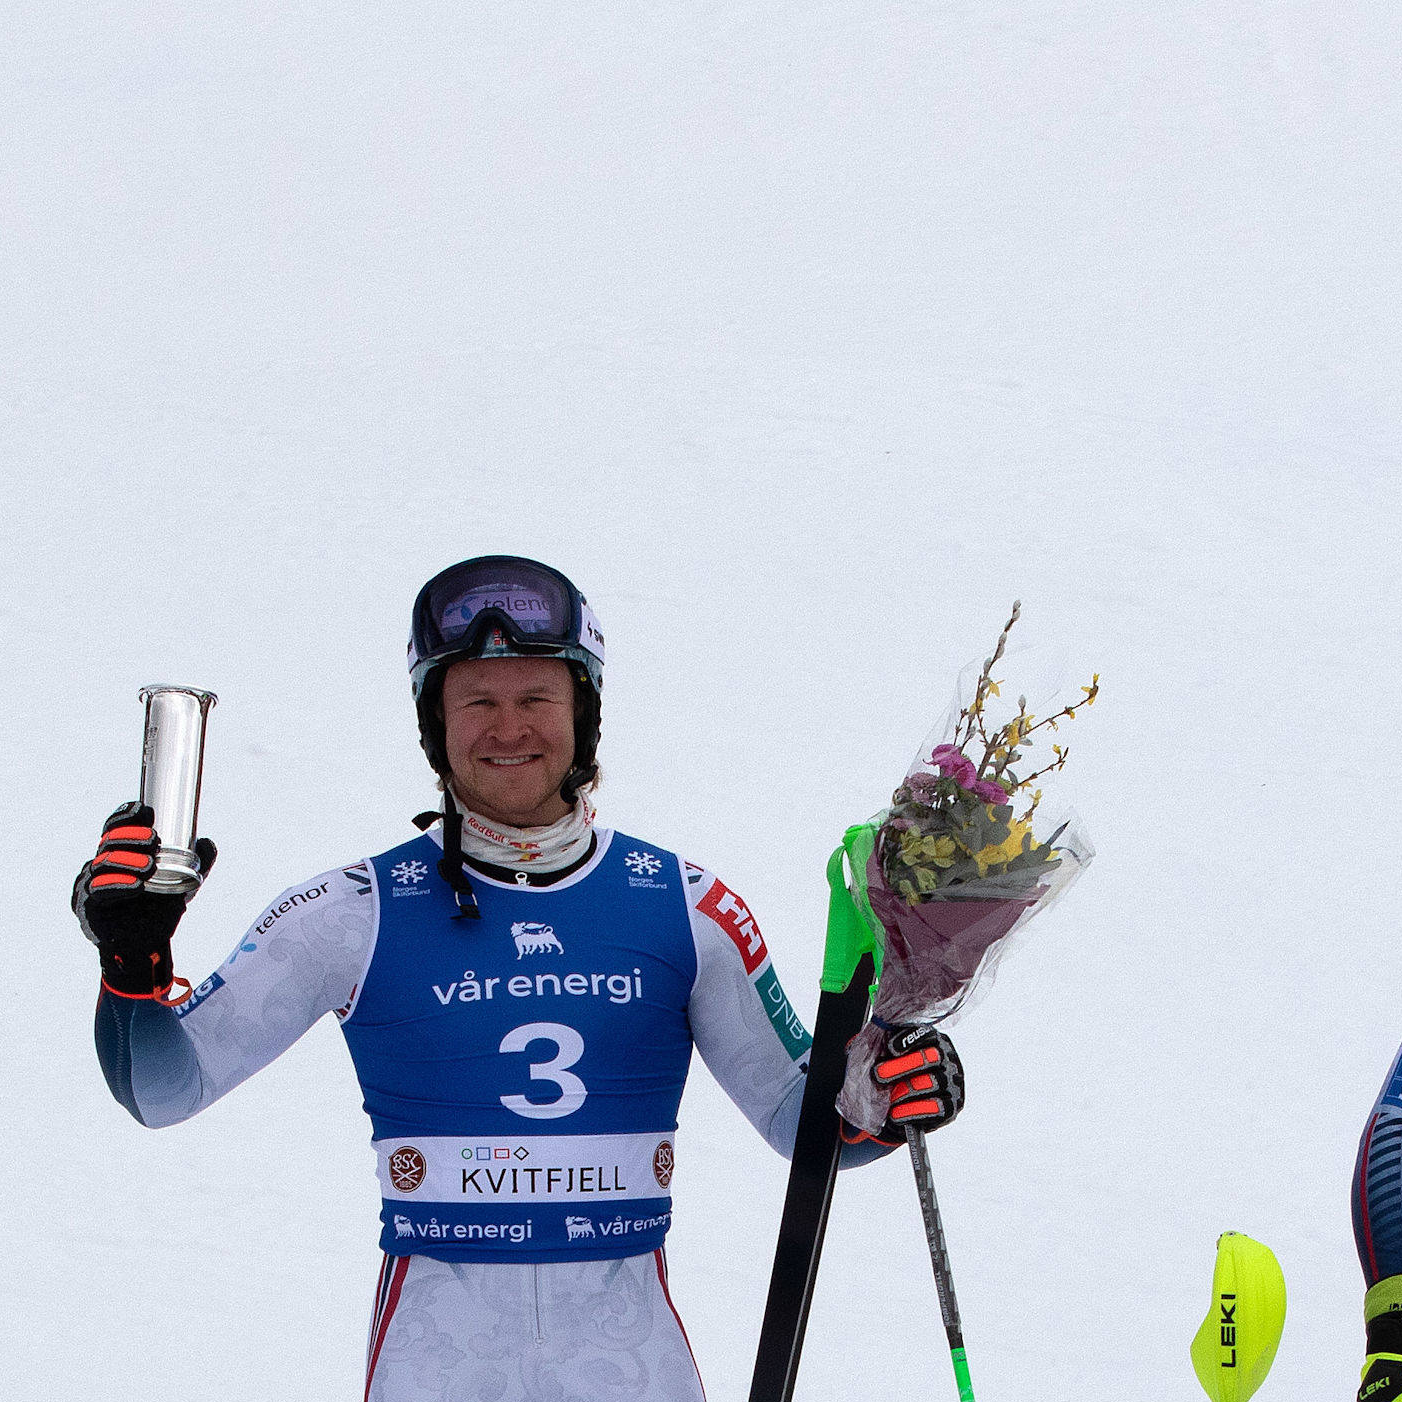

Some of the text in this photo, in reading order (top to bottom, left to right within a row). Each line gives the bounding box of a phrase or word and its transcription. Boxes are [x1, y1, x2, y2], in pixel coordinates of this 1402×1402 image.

[255, 880, 329, 935] telenor
[716, 890, 763, 957] HH
[432, 968, 642, 1005] vår energi
[767, 980, 804, 1040] DNB
[498, 1022, 588, 1120] 3
[461, 1166, 626, 1193] KVITFJELL
[416, 1218, 532, 1242] vår energi
[599, 1216, 631, 1236] vår
[1220, 1293, 1236, 1368] LEKI
[1359, 1376, 1390, 1401] LEKI
